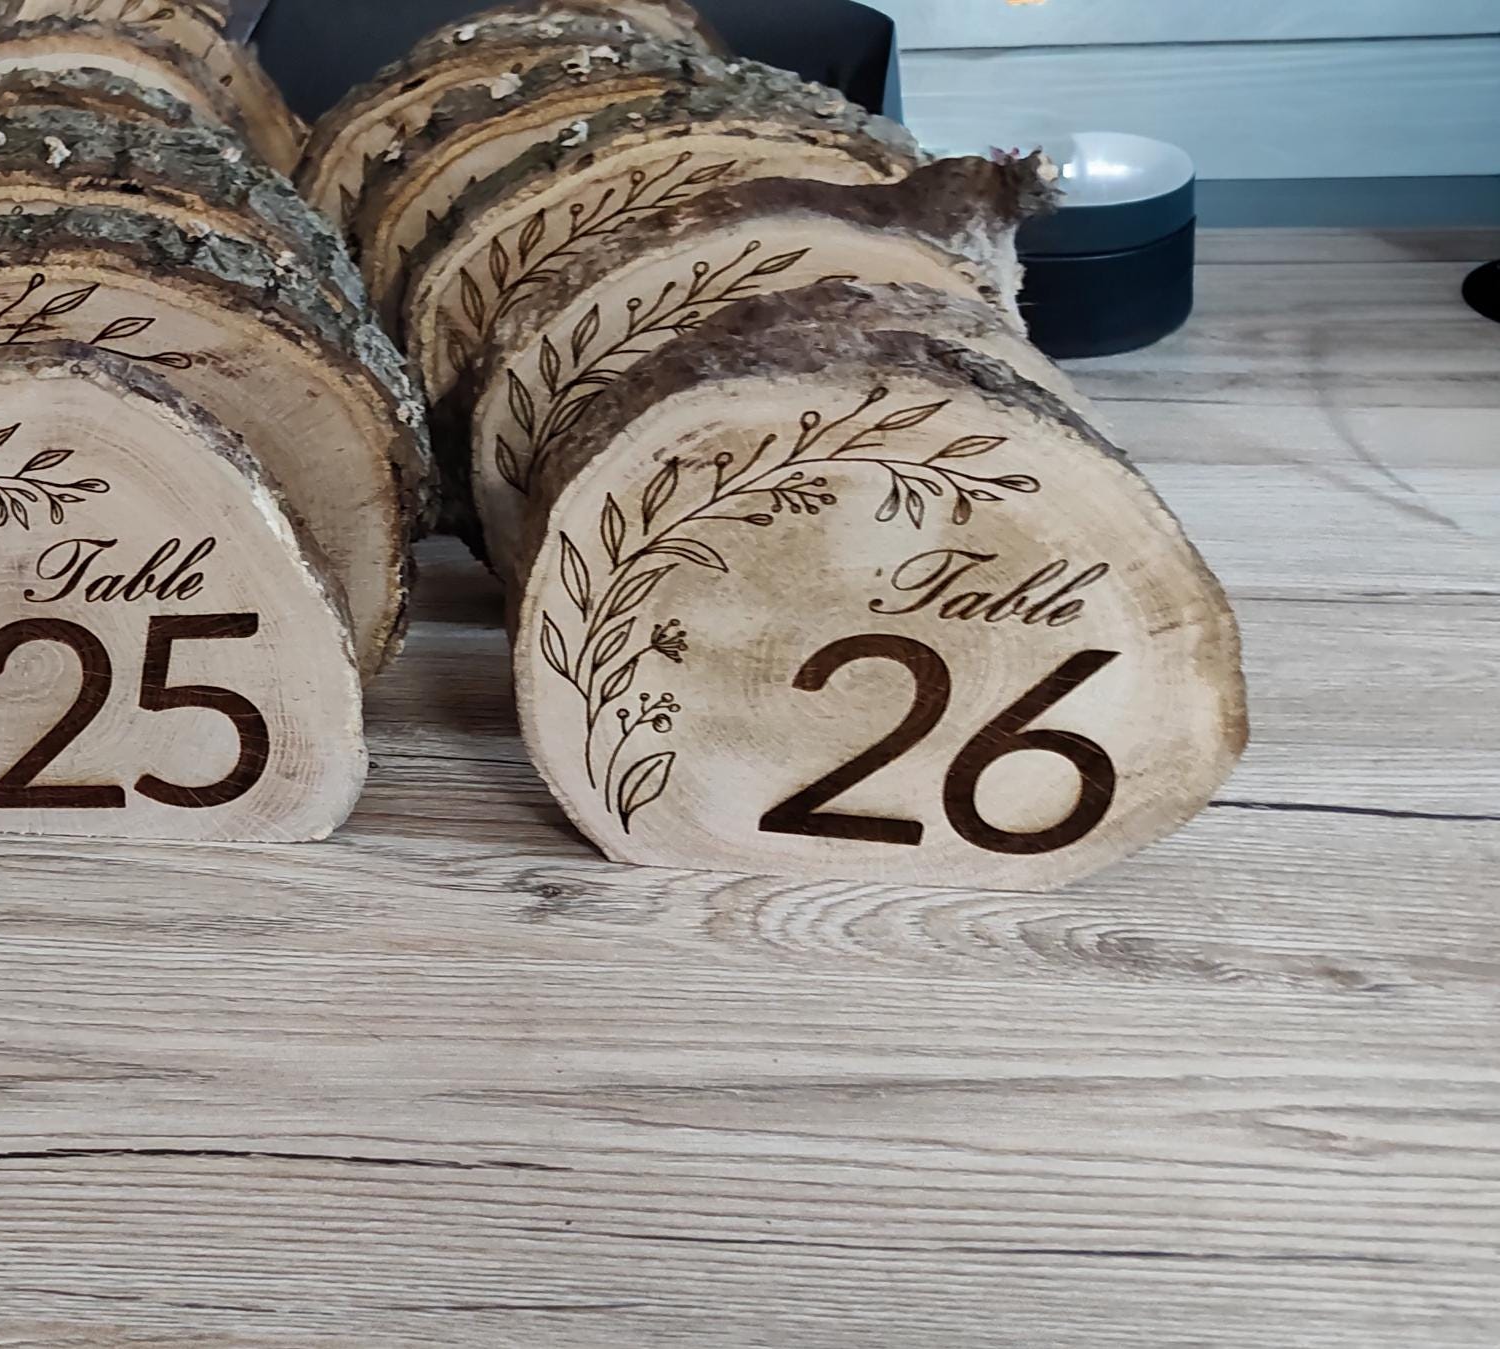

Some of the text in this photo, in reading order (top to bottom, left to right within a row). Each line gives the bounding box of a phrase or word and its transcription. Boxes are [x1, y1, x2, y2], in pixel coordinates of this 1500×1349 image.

[23, 536, 217, 603] Table
[868, 548, 1111, 628] Table
[757, 632, 1123, 856] 26
